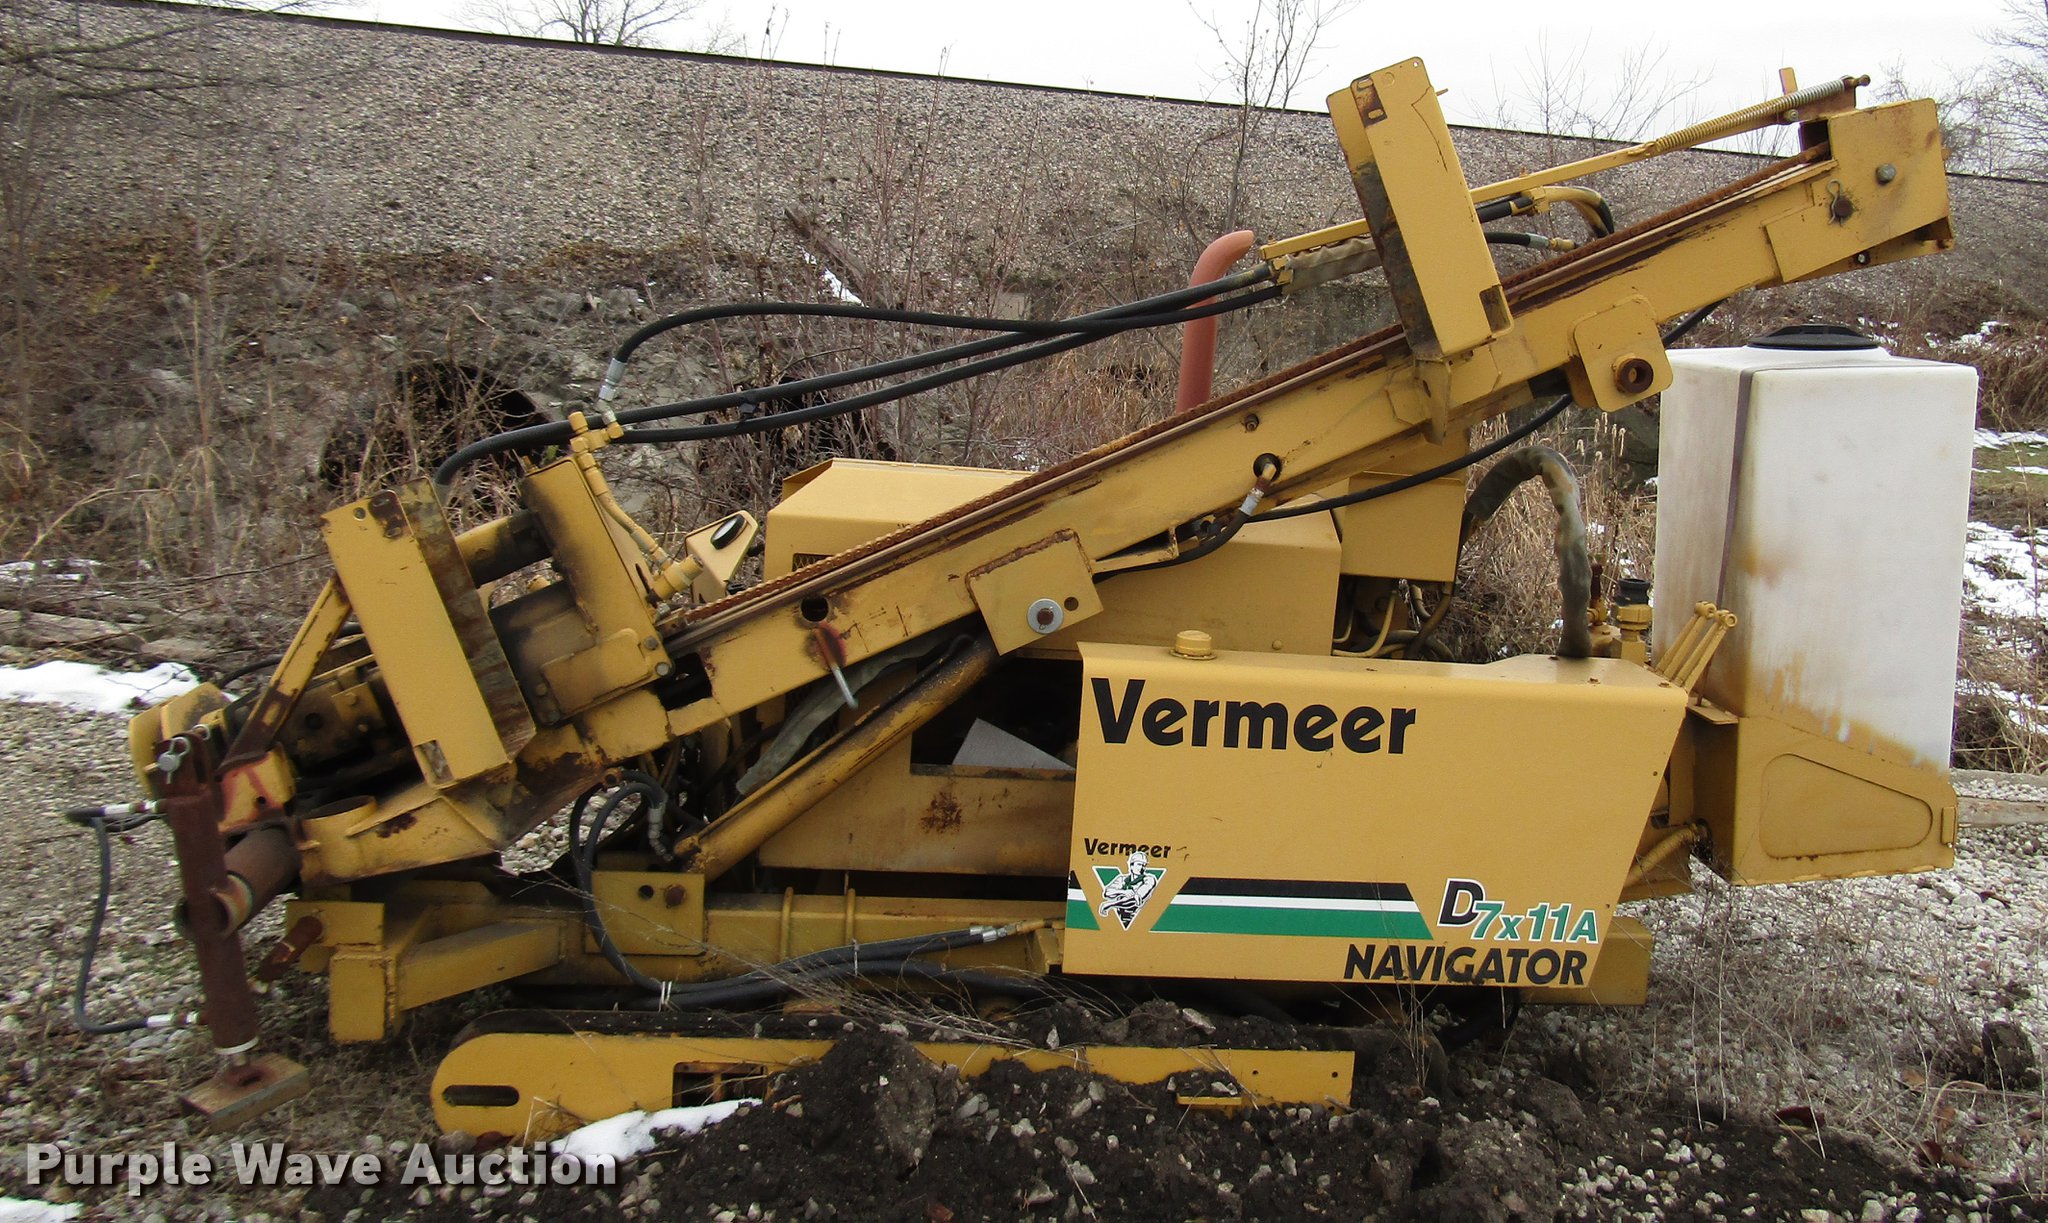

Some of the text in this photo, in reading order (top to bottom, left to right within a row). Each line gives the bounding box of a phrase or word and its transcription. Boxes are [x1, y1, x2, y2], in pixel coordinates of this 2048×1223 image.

[1091, 678, 1416, 754] Vermeer
[1084, 838, 1171, 858] Vermeer
[1437, 878, 1599, 944] D7x11A
[1344, 944, 1587, 986] NAVIGATOR
